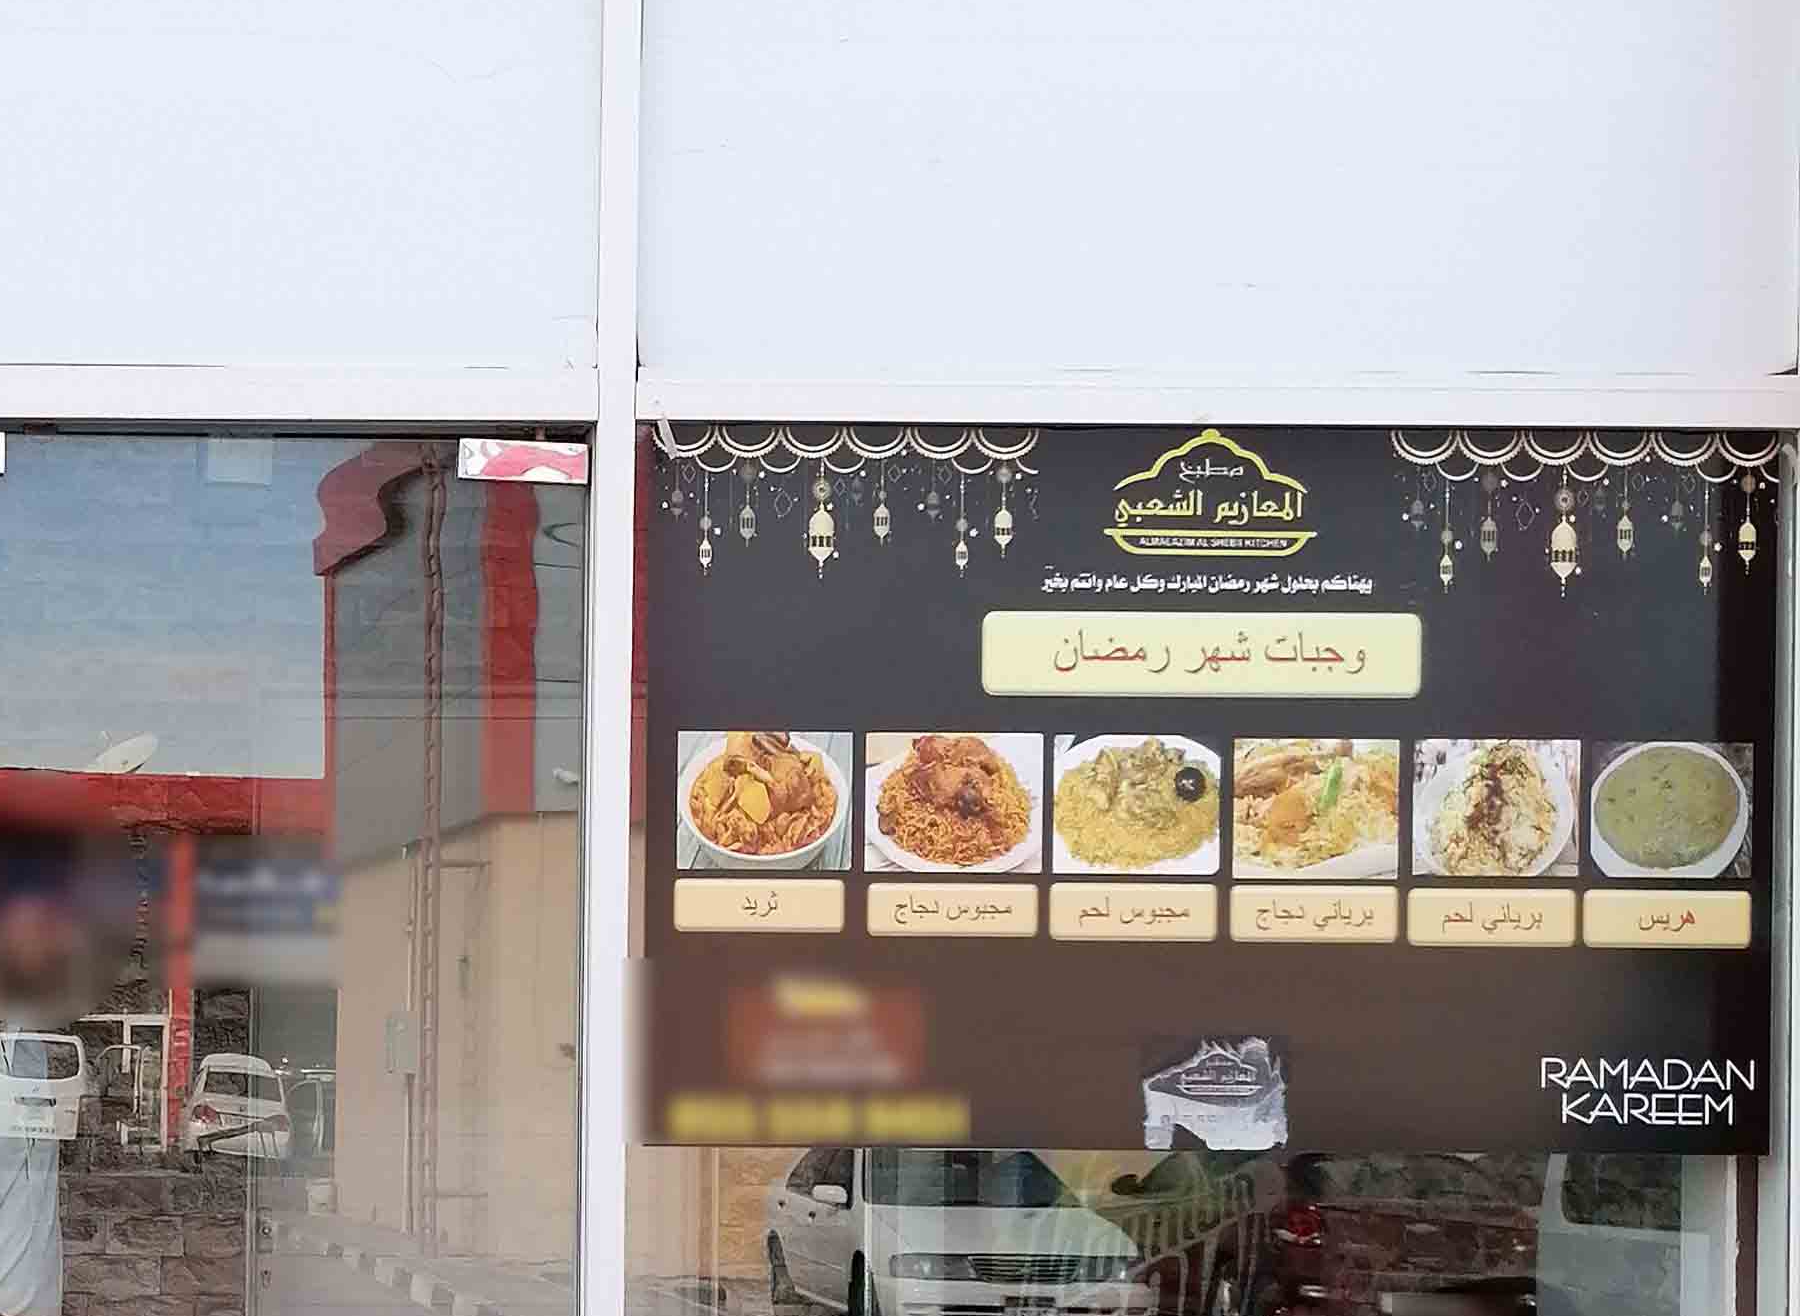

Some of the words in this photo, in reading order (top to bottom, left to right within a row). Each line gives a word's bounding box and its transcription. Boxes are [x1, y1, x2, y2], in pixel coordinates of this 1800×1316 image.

[1179, 458, 1244, 483] مطبخ
[1114, 489, 1203, 527] الشعبي
[1213, 490, 1303, 525] المعازيم
[1105, 574, 1128, 593] عام
[1054, 629, 1171, 674] رمضان
[1184, 630, 1251, 674] شهر
[1264, 630, 1367, 674] وجبات
[741, 891, 779, 916] ثريد
[946, 899, 1013, 921] مجبوس
[1078, 895, 1111, 927] لحم
[1119, 902, 1191, 925] مجبوس
[1312, 900, 1375, 929] برياني
[1442, 902, 1474, 933] لحم
[1481, 903, 1544, 933] برياني
[1638, 909, 1697, 932] هريس
[1540, 1057, 1756, 1091] RAMADAN
[1561, 1093, 1734, 1126] KAREEM
